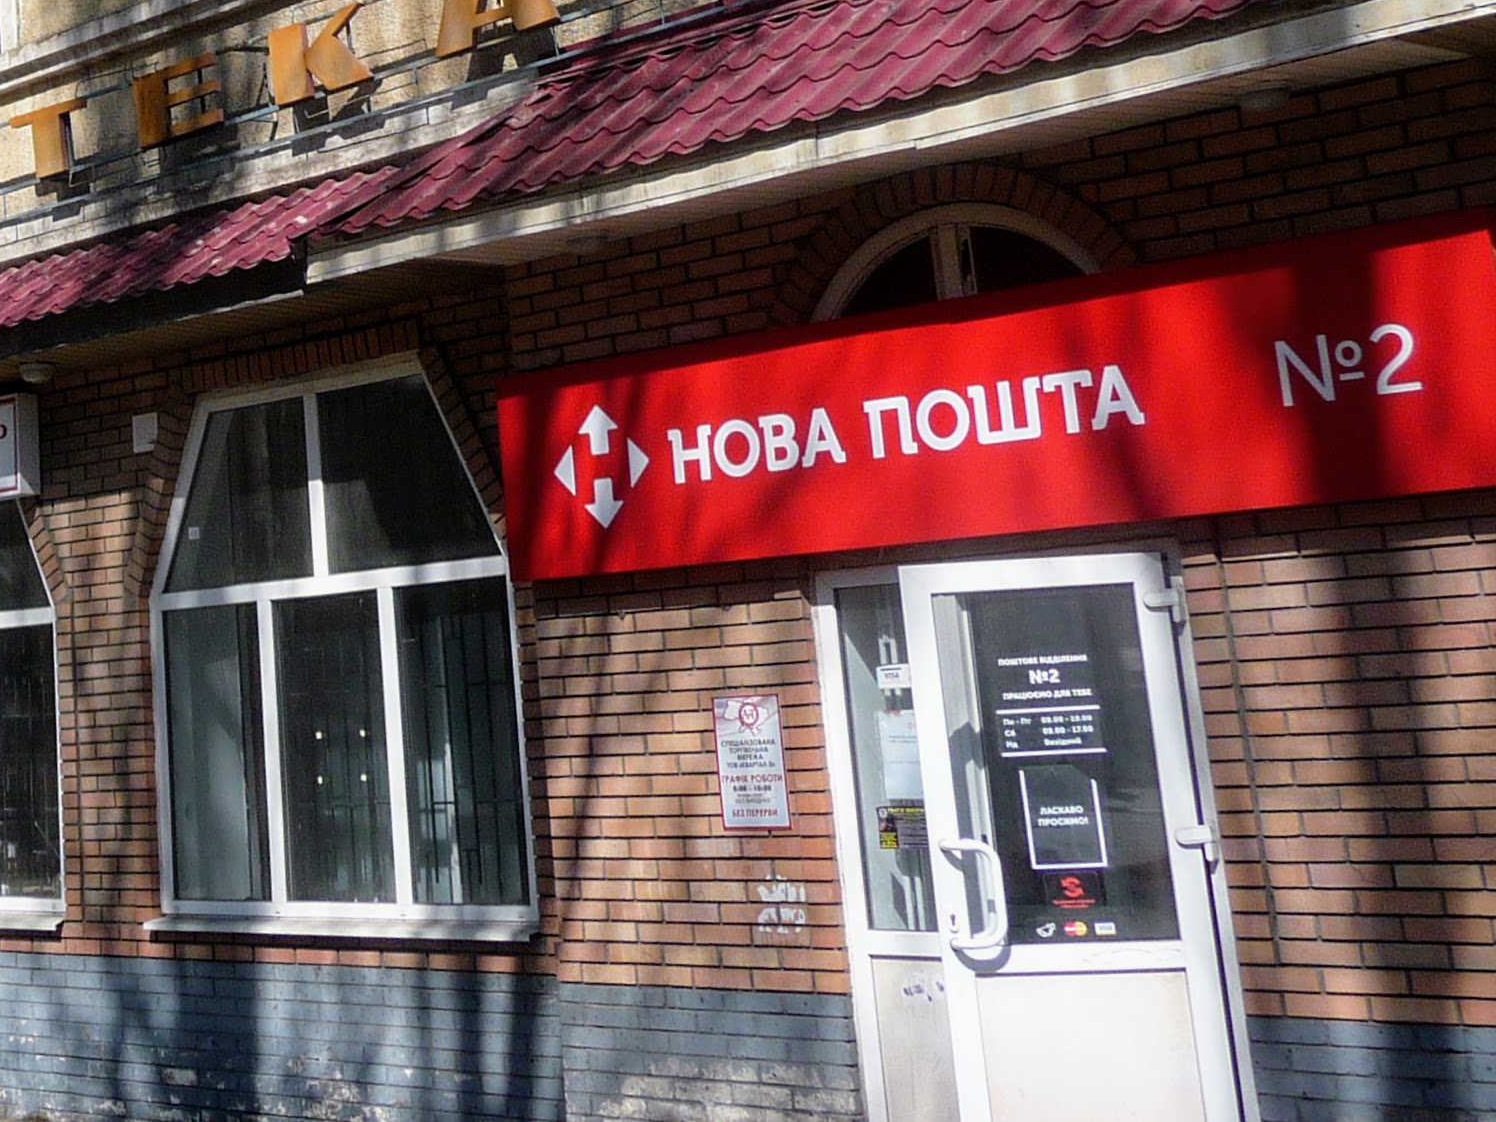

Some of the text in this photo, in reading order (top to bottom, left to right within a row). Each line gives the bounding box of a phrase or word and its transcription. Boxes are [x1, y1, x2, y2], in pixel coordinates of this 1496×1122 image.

[667, 406, 847, 486] НОВА
[863, 364, 1146, 461] ПОШТА
[1028, 668, 1061, 684] №2
[750, 773, 783, 783] РОБОТИ
[732, 808, 778, 817] БЕЗ ПЕРЕРВИ
[1039, 805, 1084, 815] ЛАСКАВО
[1037, 816, 1089, 827] ПРОСИМО!
